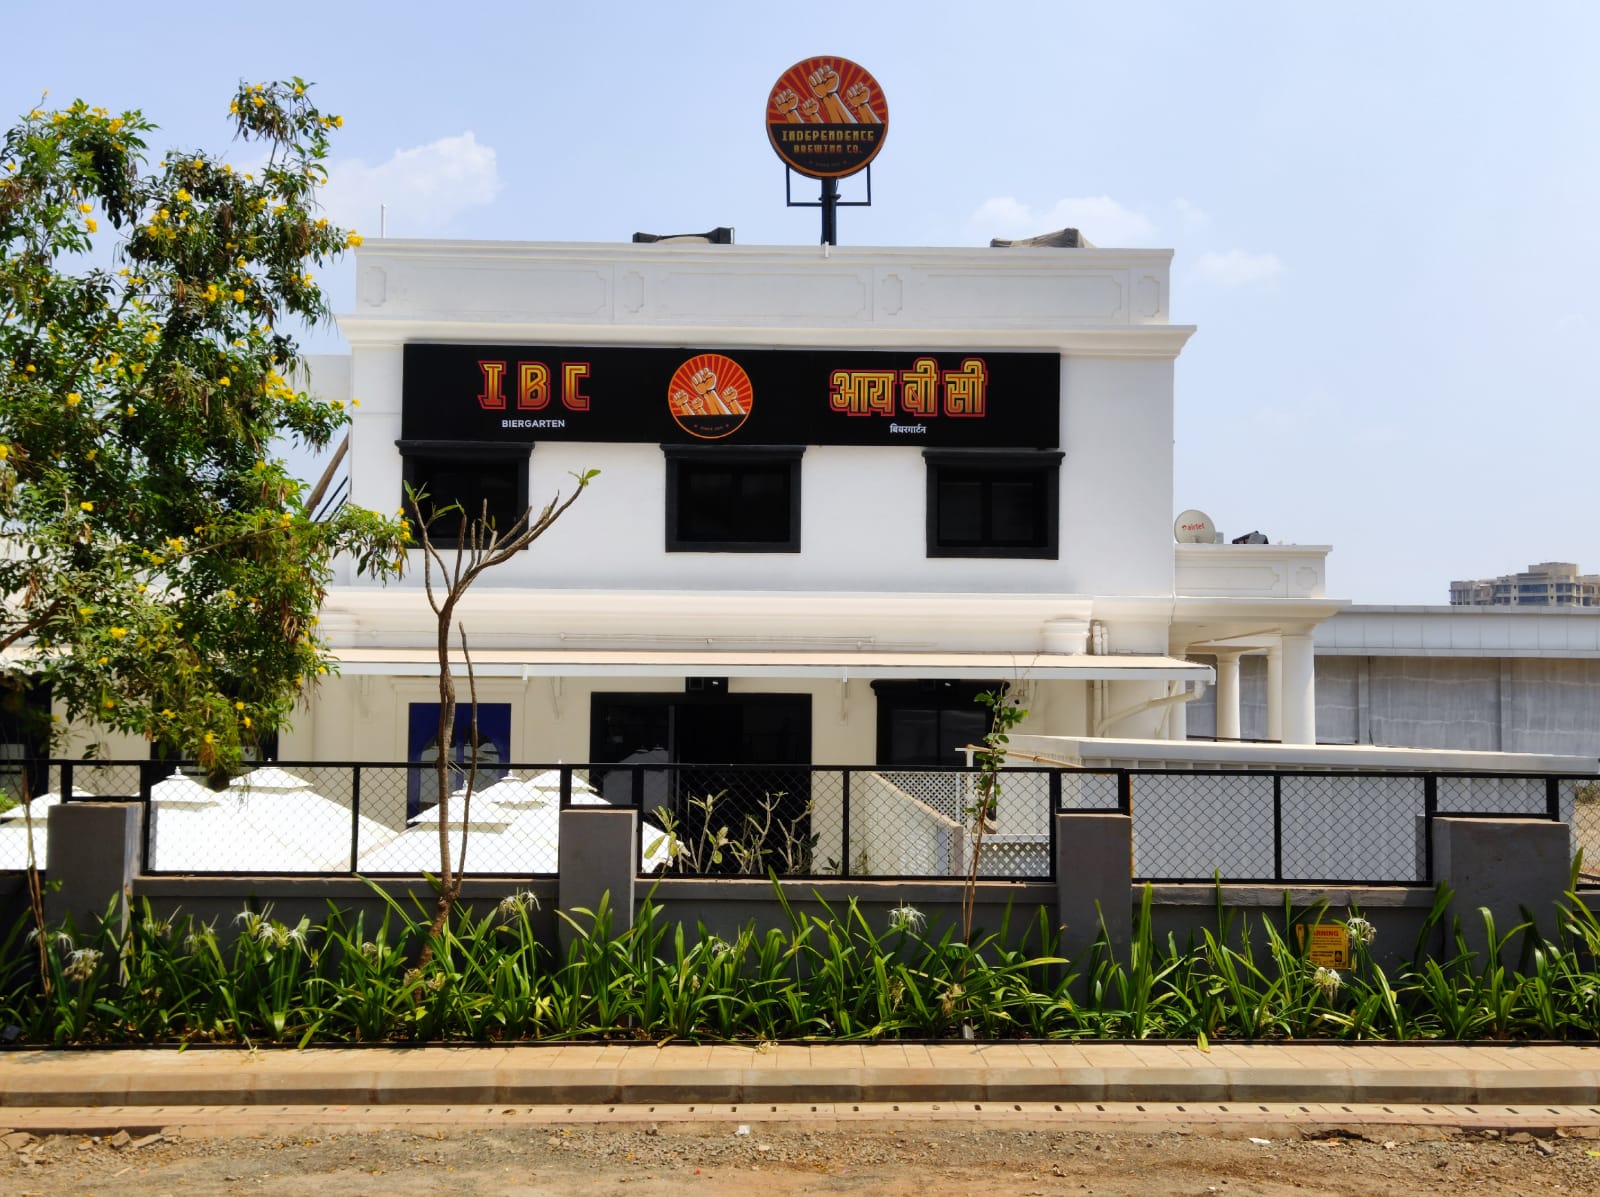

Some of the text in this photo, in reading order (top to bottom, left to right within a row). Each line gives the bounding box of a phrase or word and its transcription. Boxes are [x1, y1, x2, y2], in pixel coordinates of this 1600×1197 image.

[781, 130, 875, 142] INDEPENDENCE
[793, 144, 842, 154] BREWING
[501, 419, 566, 428] BIERGARTEN
[1186, 522, 1206, 532] airtel
